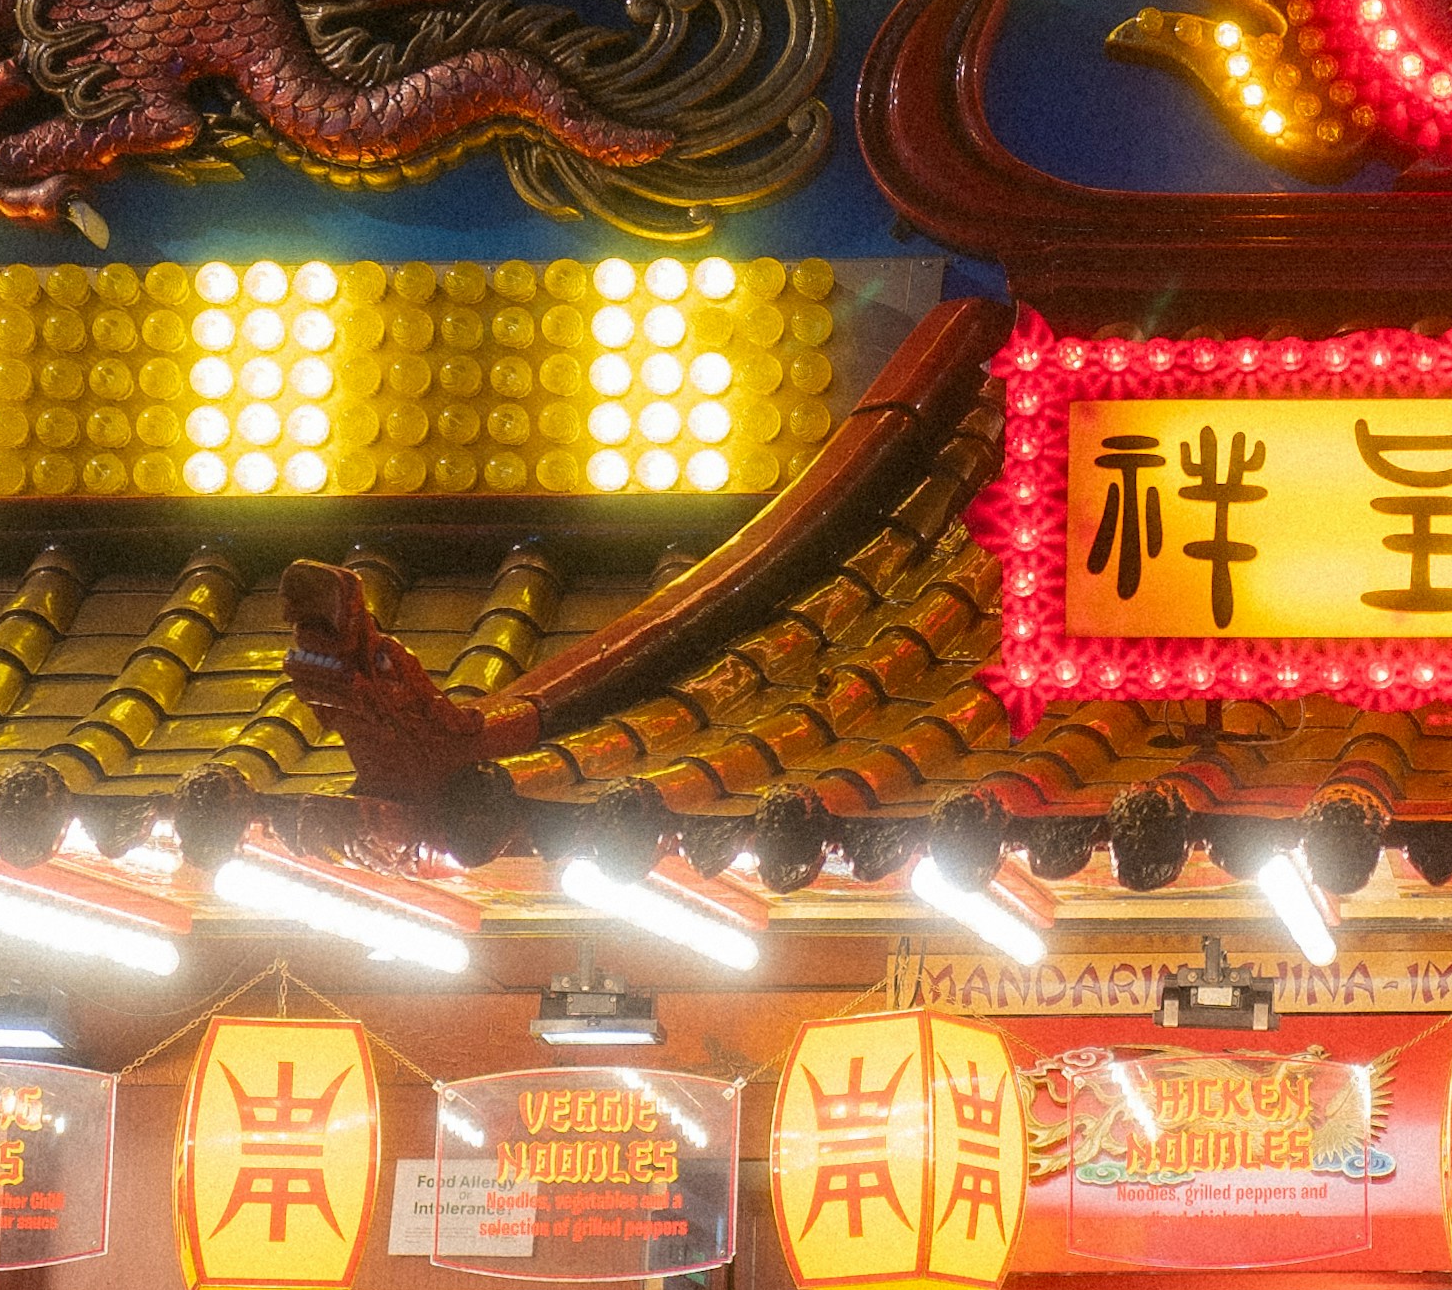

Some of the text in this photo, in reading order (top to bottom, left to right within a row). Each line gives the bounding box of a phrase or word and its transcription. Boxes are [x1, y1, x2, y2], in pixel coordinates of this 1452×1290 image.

[518, 1088, 658, 1134] VEGGIE
[496, 1139, 679, 1185] NOODLES
[1125, 1128, 1315, 1175] NOODLES
[417, 1175, 516, 1195] Food Allergy
[1116, 1182, 1328, 1206] Noodles, grilled peppers and
[640, 1191, 669, 1209] and
[672, 1193, 683, 1209] a
[479, 1217, 551, 1237] selection
[552, 1216, 570, 1237] of
[572, 1216, 622, 1243] grilled
[624, 1219, 689, 1241] peppers
